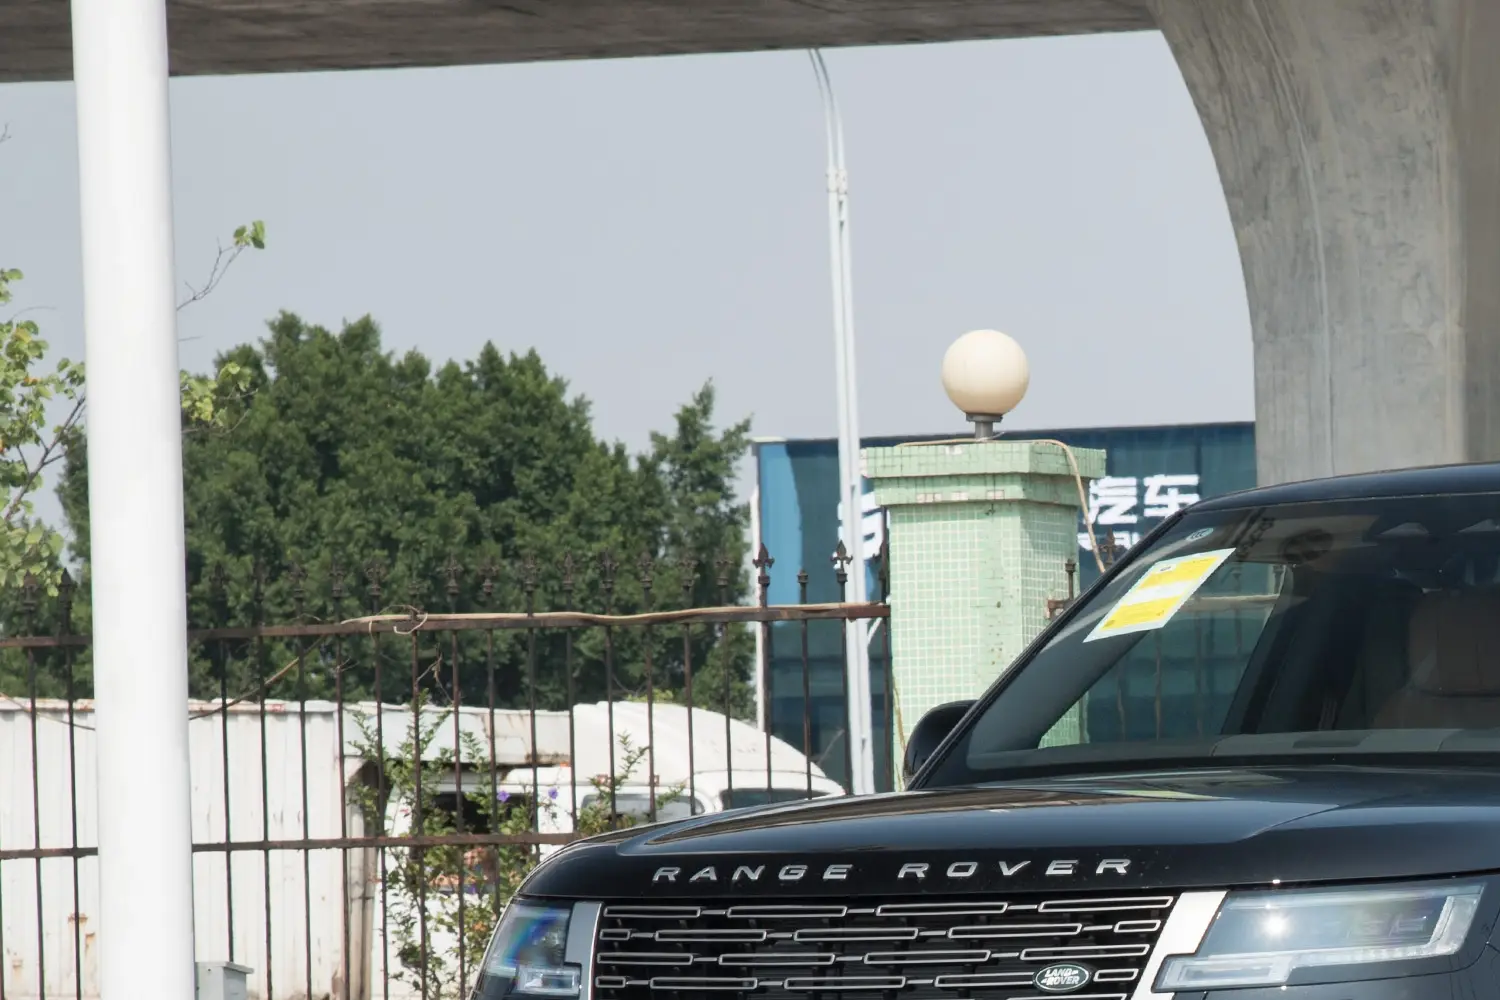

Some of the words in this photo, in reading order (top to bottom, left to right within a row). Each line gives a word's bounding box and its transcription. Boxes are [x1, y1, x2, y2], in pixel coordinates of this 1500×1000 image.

[1083, 474, 1200, 524] 汽车
[652, 864, 853, 882] RANGE
[898, 858, 1131, 880] ROVER
[1044, 967, 1073, 977] LAND
[1046, 976, 1080, 986] ROVER
